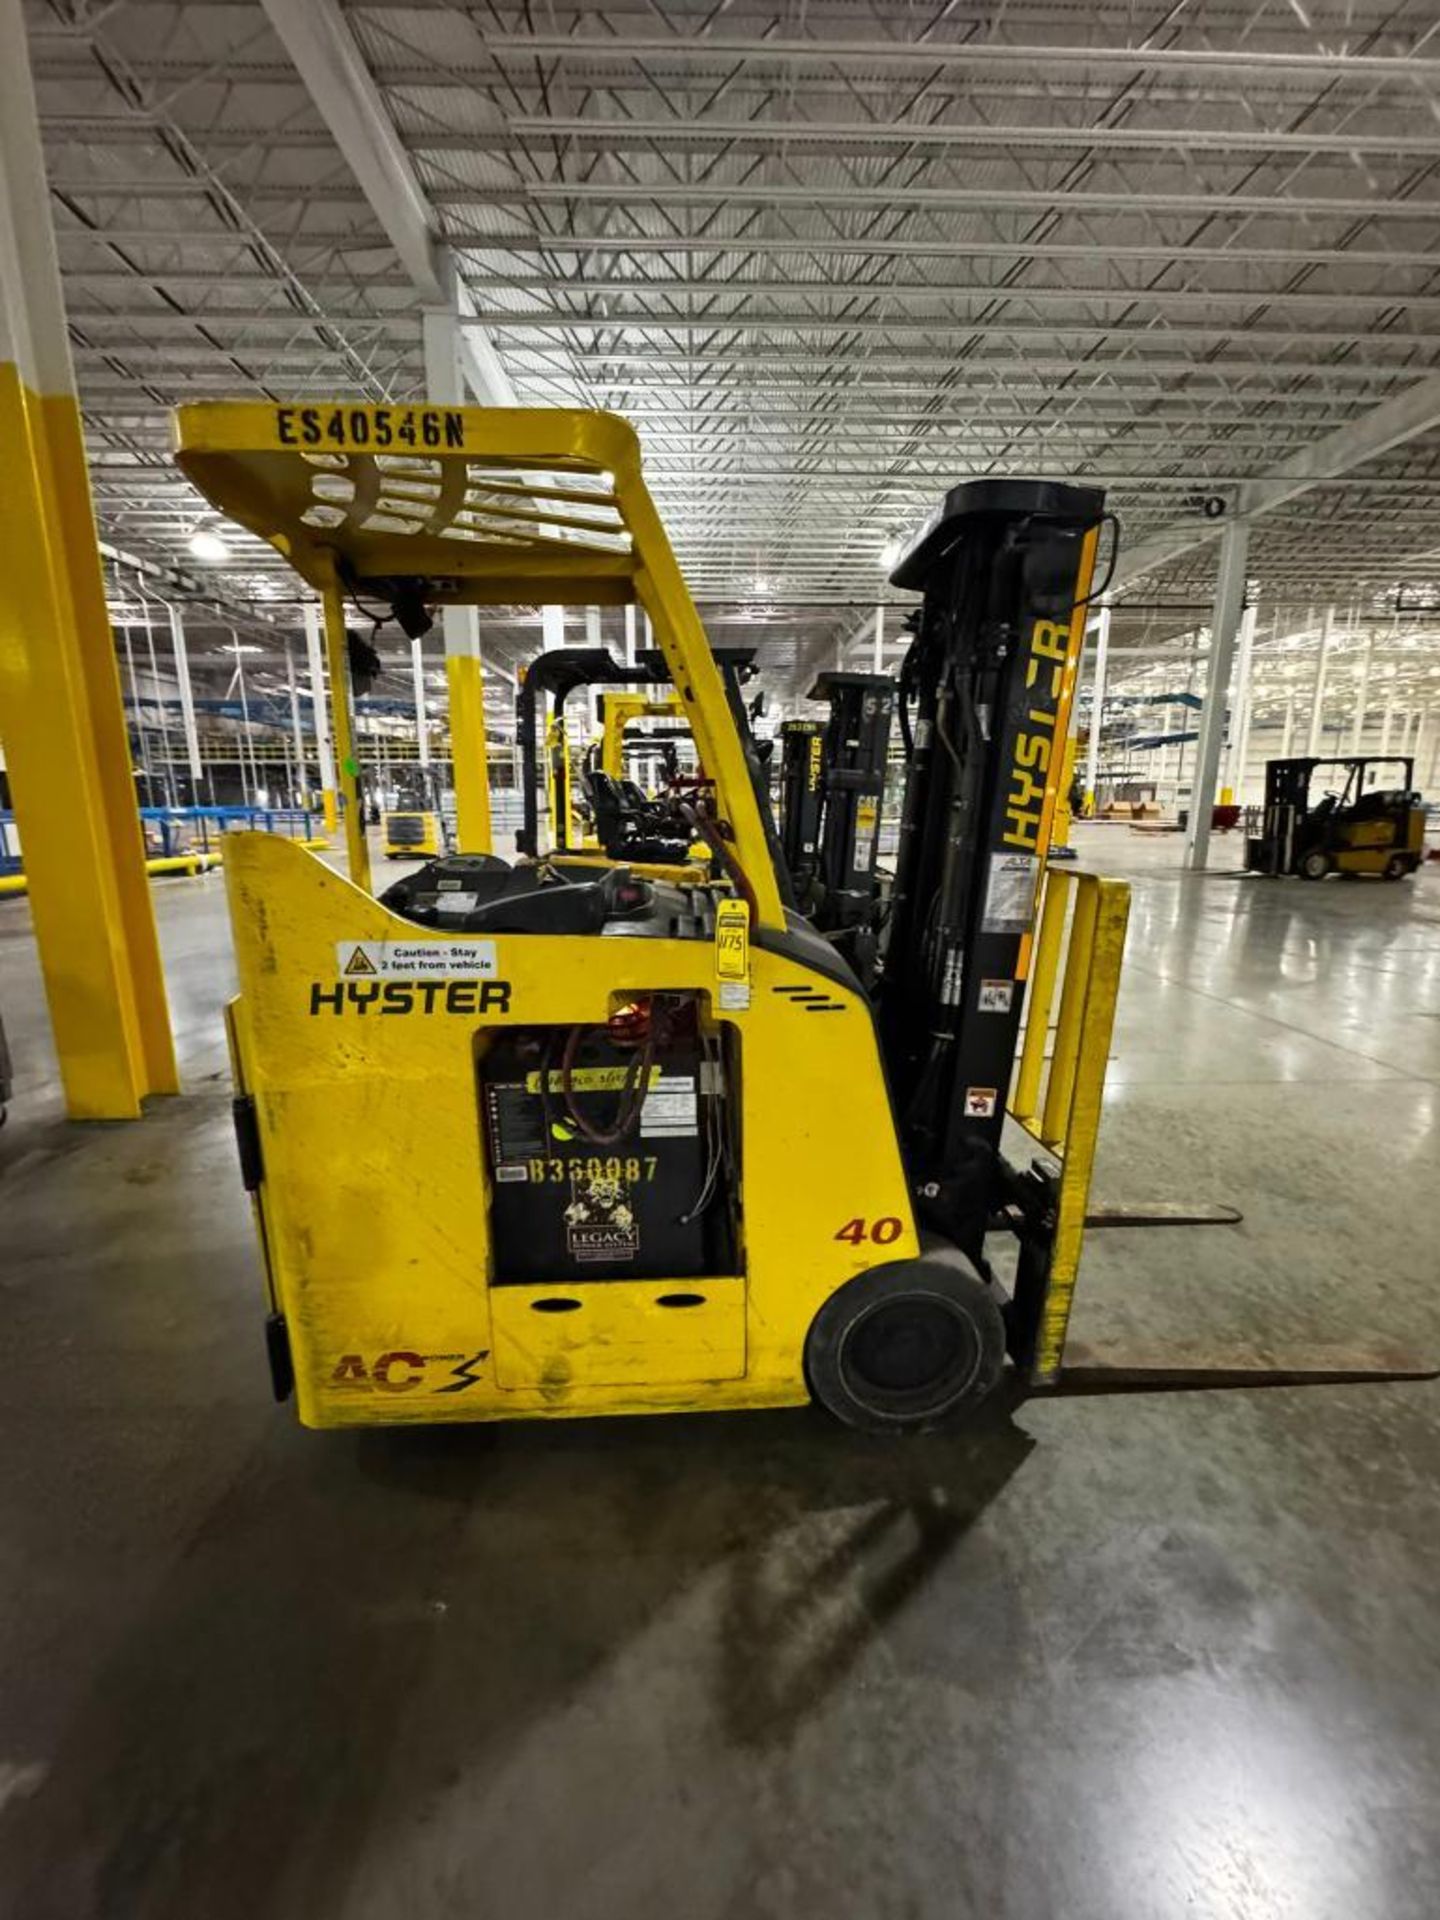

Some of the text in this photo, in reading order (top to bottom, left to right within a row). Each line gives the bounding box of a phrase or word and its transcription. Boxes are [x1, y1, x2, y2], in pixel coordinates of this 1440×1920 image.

[277, 408, 465, 448] ES40546N
[381, 960, 492, 970] 2 feet from vehicle
[394, 948, 440, 958] Caution
[450, 947, 478, 959] Stay
[310, 981, 512, 1016] HYSTER
[571, 1231, 637, 1243] LEGACY
[833, 1216, 903, 1246] 40
[328, 1352, 426, 1393] AC
